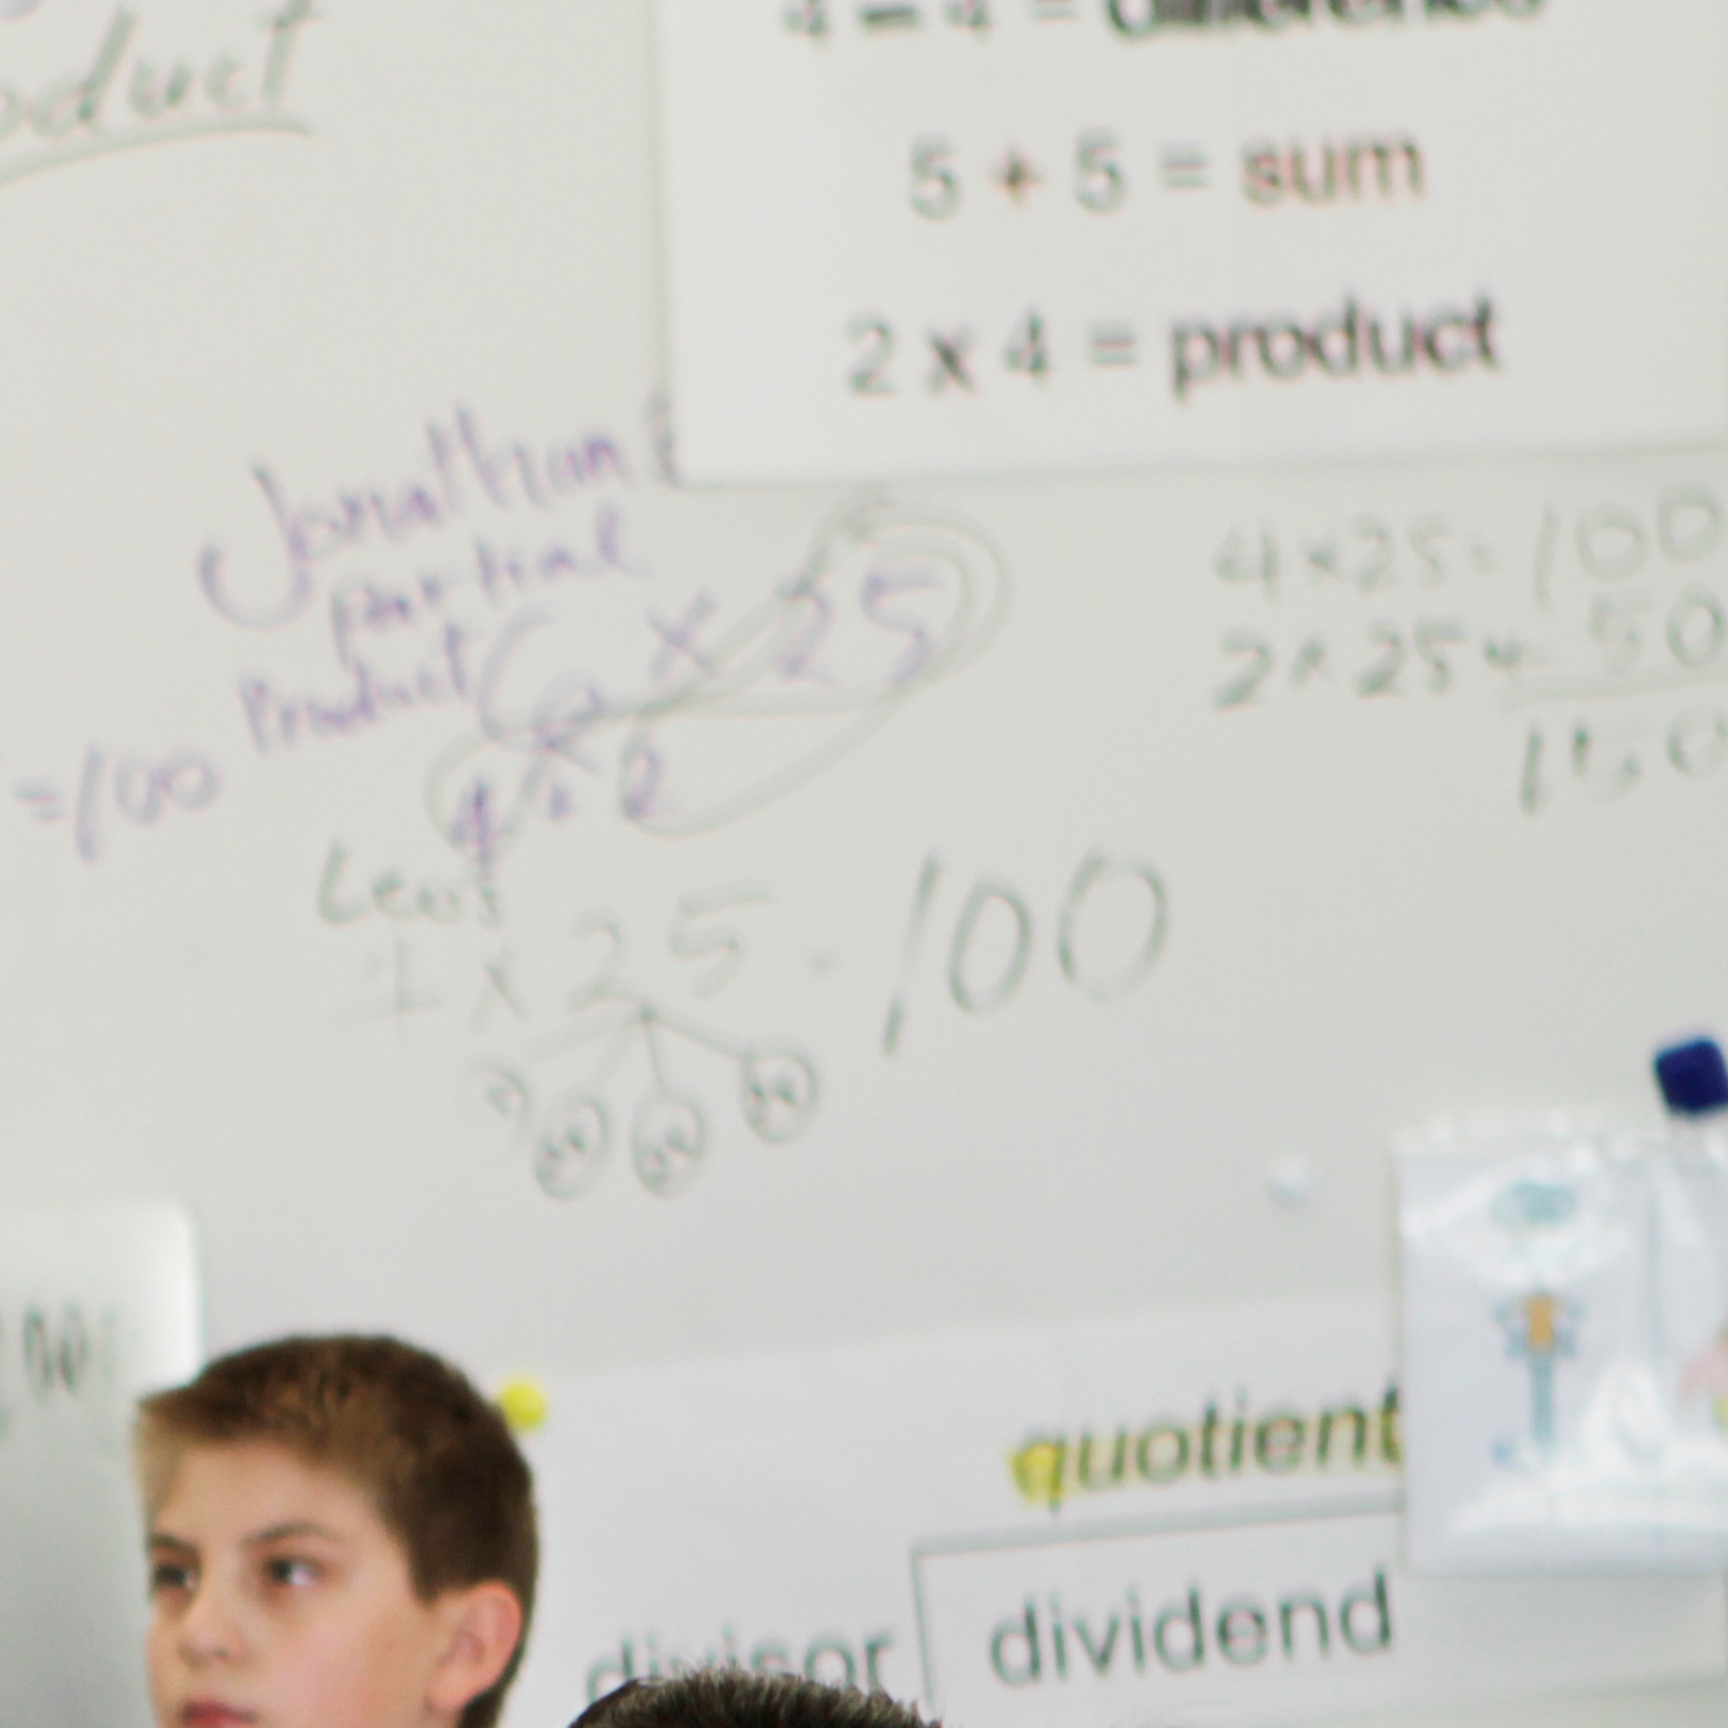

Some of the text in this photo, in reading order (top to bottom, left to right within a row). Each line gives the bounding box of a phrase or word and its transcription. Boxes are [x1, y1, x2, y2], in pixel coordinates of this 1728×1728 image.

[909, 135, 964, 220] 5
[1074, 127, 1127, 213] 5
[1242, 130, 1428, 205] sum
[847, 312, 896, 396] 2
[924, 325, 976, 392] x
[1000, 306, 1054, 384] 4
[1168, 288, 1504, 408] product
[878, 848, 1174, 1062] 100
[1010, 1385, 1404, 1514] quotient
[586, 1624, 899, 1702] diisor
[990, 1568, 1394, 1690] dividend
